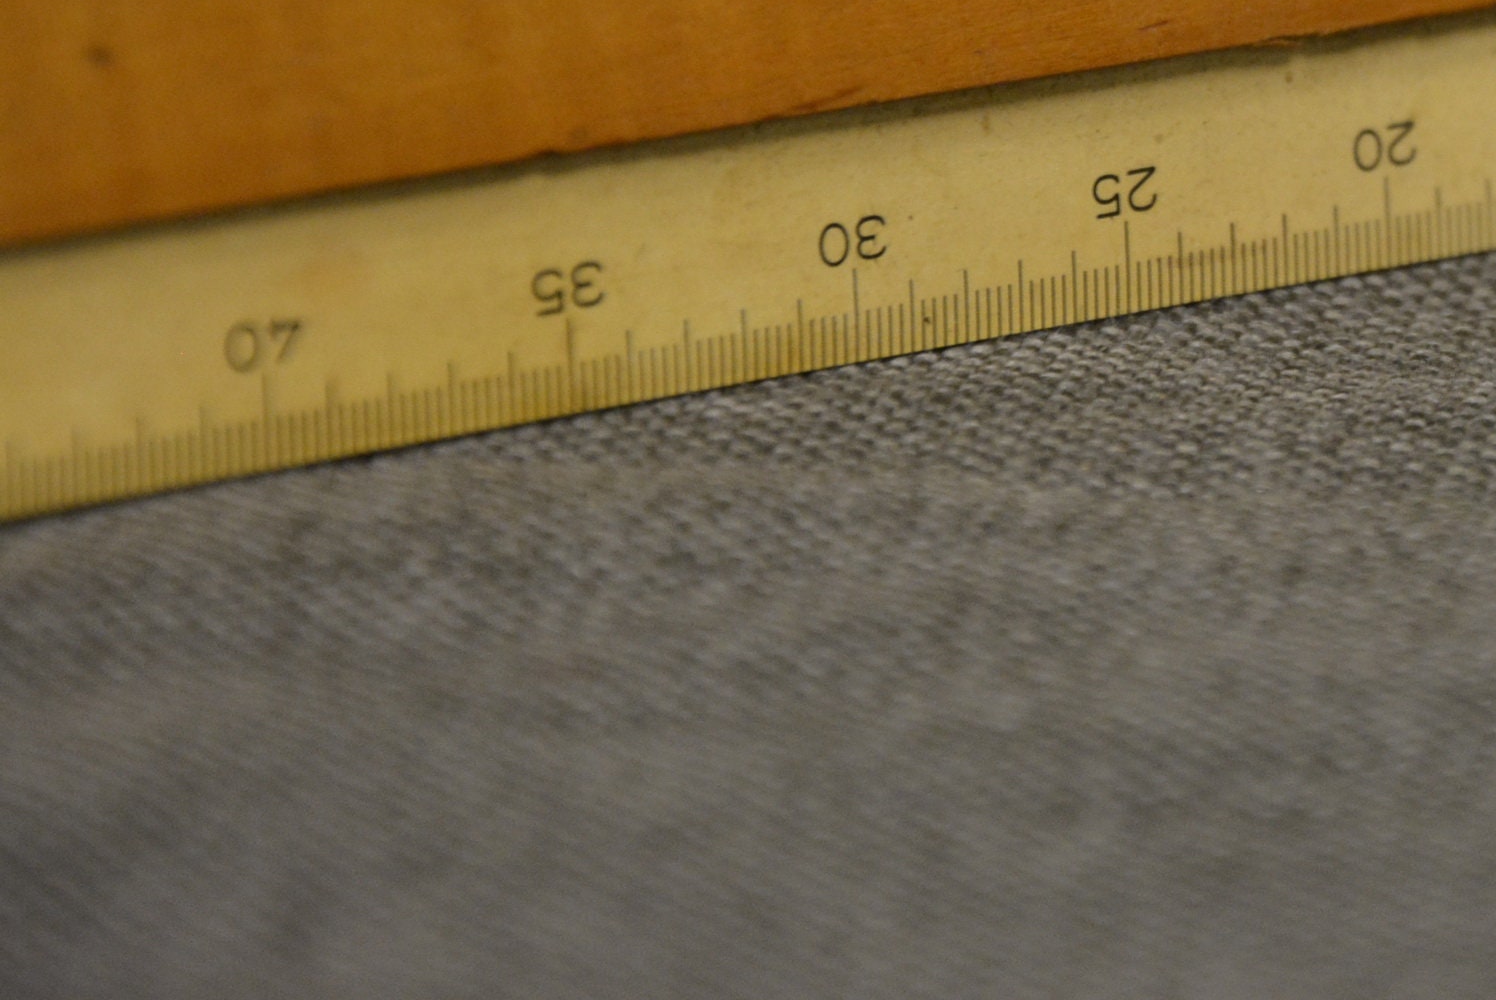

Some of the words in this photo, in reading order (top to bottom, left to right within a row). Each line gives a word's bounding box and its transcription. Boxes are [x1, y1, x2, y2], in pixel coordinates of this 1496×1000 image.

[1352, 119, 1418, 172] 20
[1091, 165, 1159, 219] 25
[818, 214, 887, 268] 30
[531, 261, 607, 317] 35
[222, 318, 304, 374] 40
